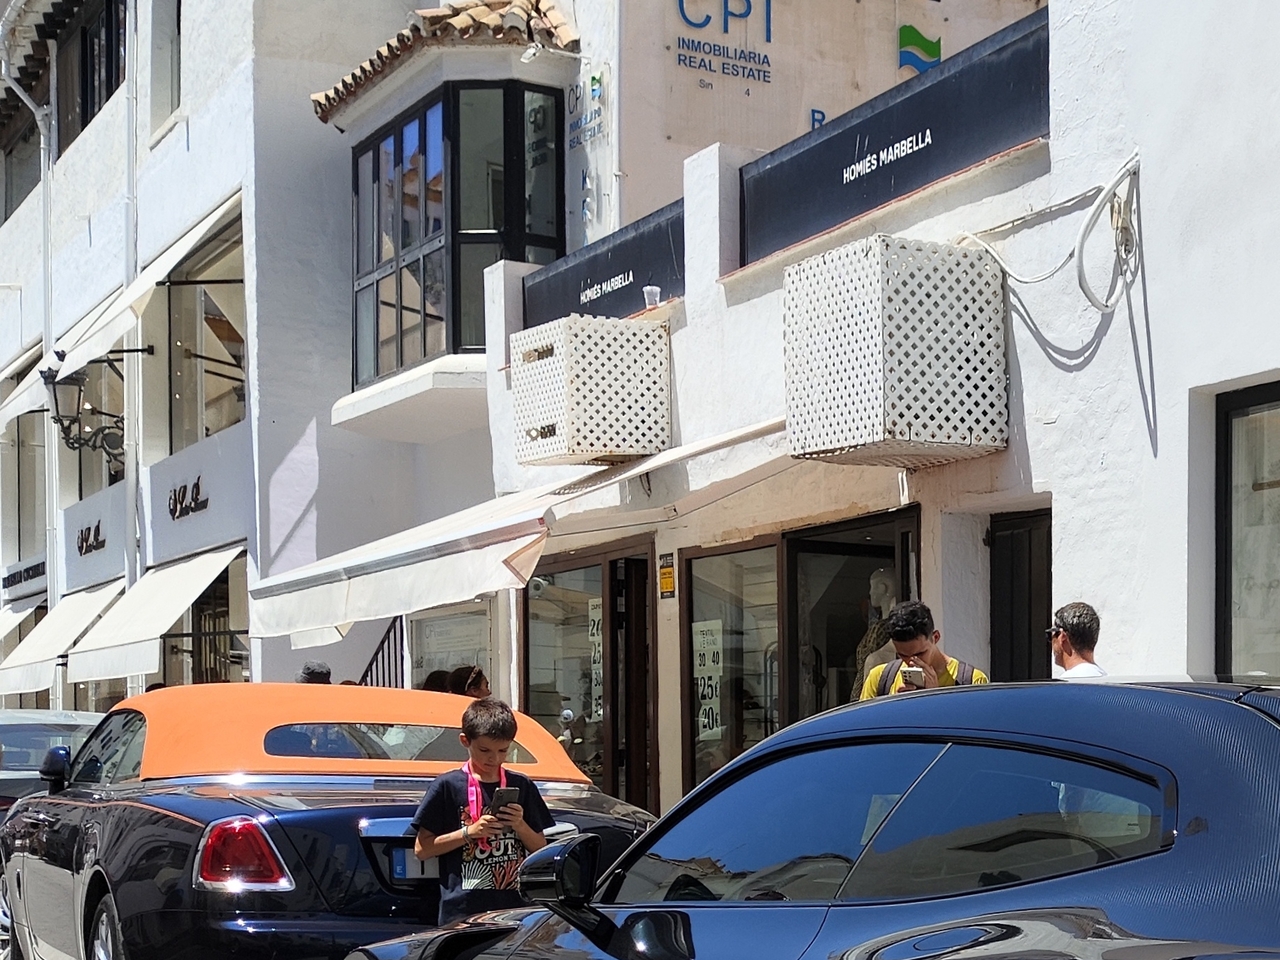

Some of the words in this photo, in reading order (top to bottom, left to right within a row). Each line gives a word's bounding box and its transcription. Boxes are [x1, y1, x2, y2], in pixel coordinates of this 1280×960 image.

[677, 36, 771, 67] INMOBILIARIA
[677, 53, 717, 73] REAL
[721, 62, 771, 83] ESTATE
[879, 128, 932, 167] MARBELLA
[602, 270, 634, 295] MARBELLA
[483, 855, 508, 865] LEMON
